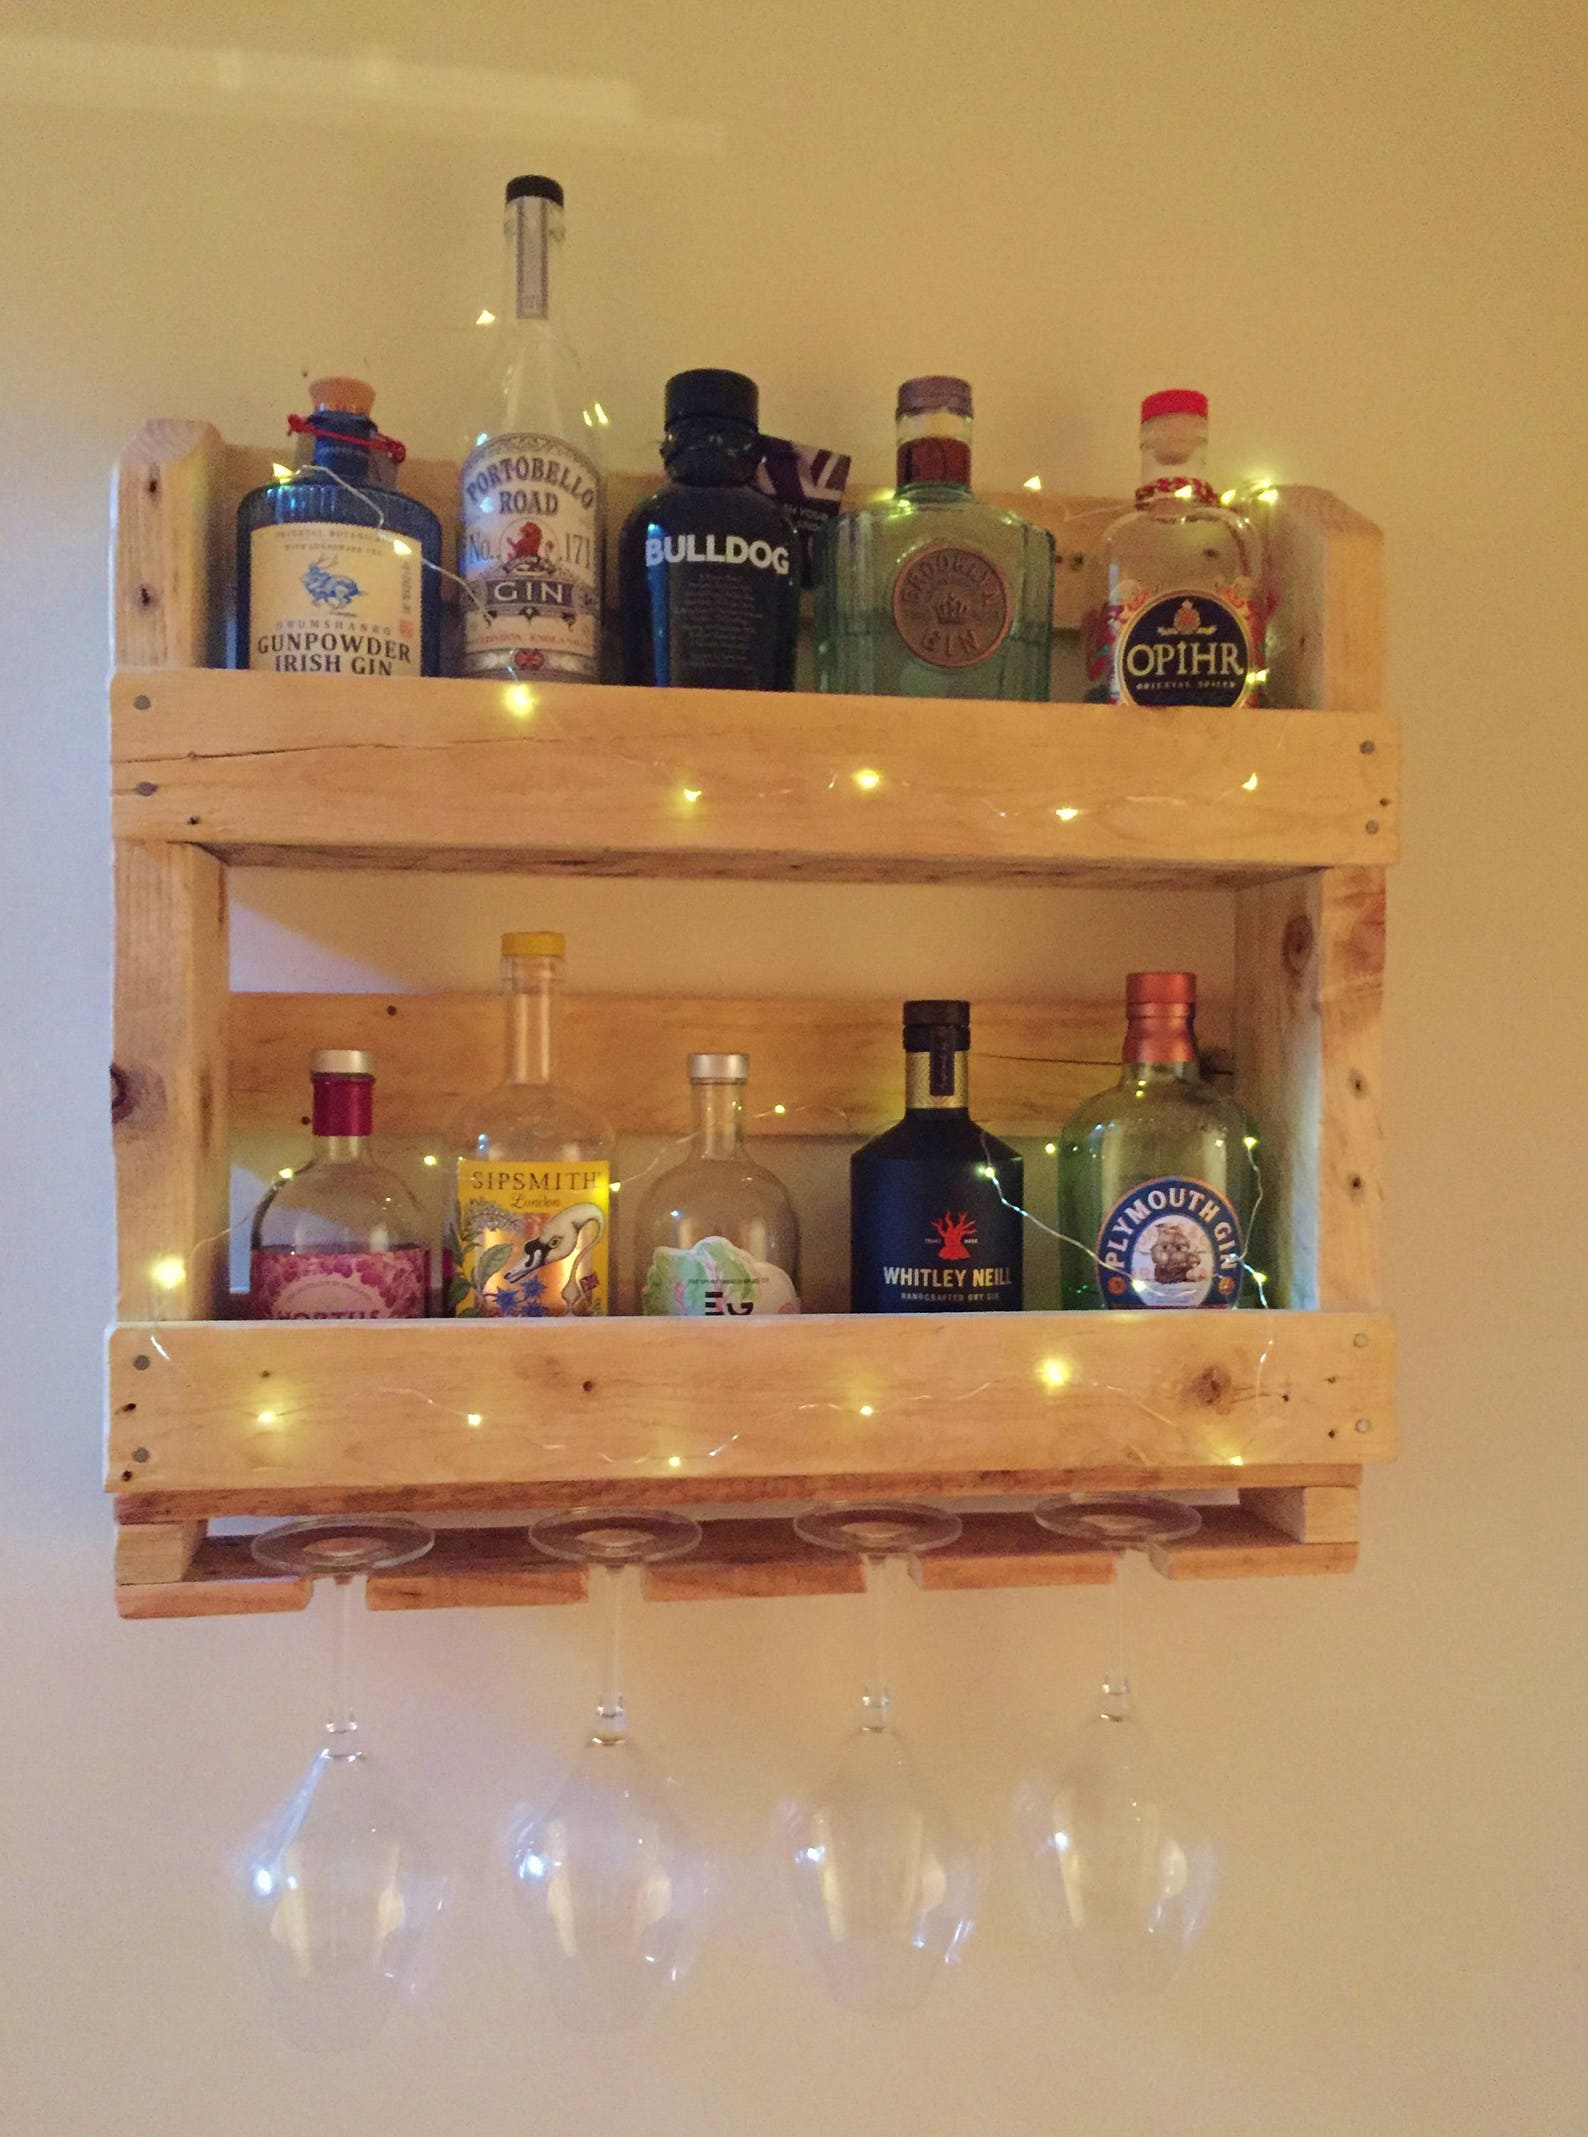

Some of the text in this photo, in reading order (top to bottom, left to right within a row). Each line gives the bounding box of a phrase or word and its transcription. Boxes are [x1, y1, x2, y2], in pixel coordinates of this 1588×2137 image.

[466, 456, 594, 510] PORTOBELLO
[499, 489, 559, 515] ROAD
[644, 534, 790, 576] BULLDOG
[494, 581, 563, 604] GIN
[257, 633, 411, 664] GUNPOWDER
[922, 629, 982, 658] GIN
[274, 653, 393, 677] IRISH GIN
[1126, 641, 1245, 677] OPIHR
[472, 1171, 597, 1191] SIPSMITH
[510, 1193, 561, 1209] London
[1105, 1187, 1238, 1270] PLYMOUTH GIN
[883, 1266, 1013, 1288] WHITLEY NEILL
